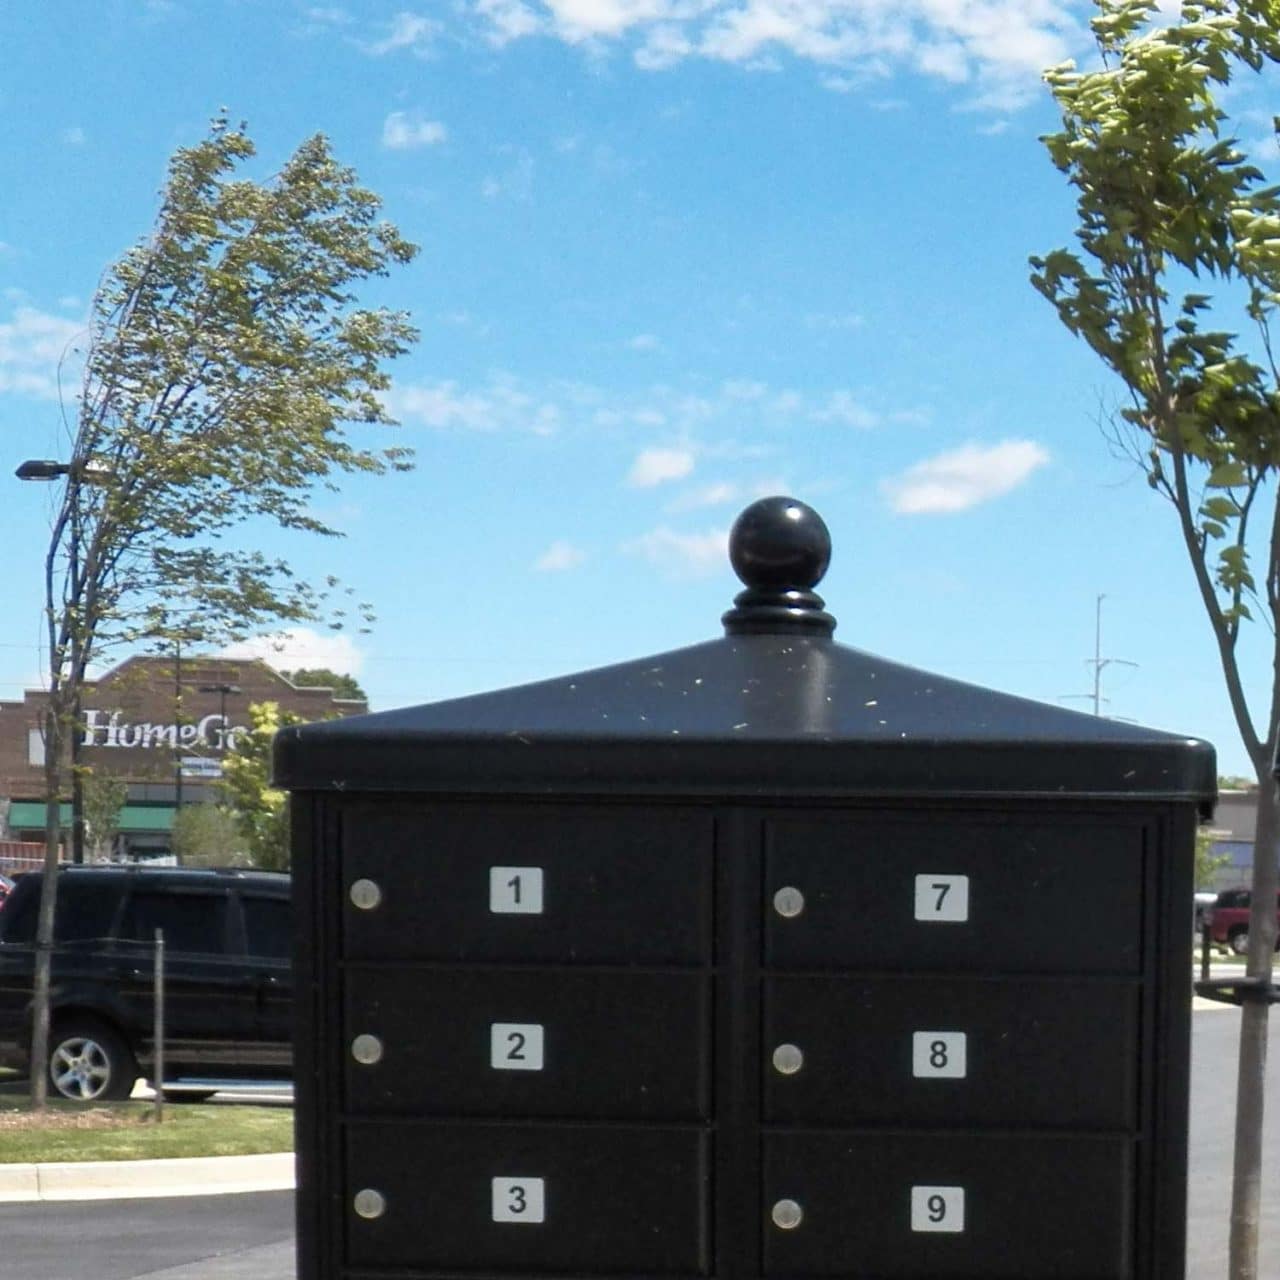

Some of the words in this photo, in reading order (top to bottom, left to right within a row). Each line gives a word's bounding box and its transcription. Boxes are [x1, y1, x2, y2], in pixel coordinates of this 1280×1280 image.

[80, 709, 252, 751] HomeGo
[506, 874, 522, 905] 1
[931, 882, 952, 912] 7
[506, 1031, 526, 1061] 2
[929, 1039, 949, 1070] 8
[508, 1185, 528, 1215] 3
[927, 1194, 947, 1224] 9
